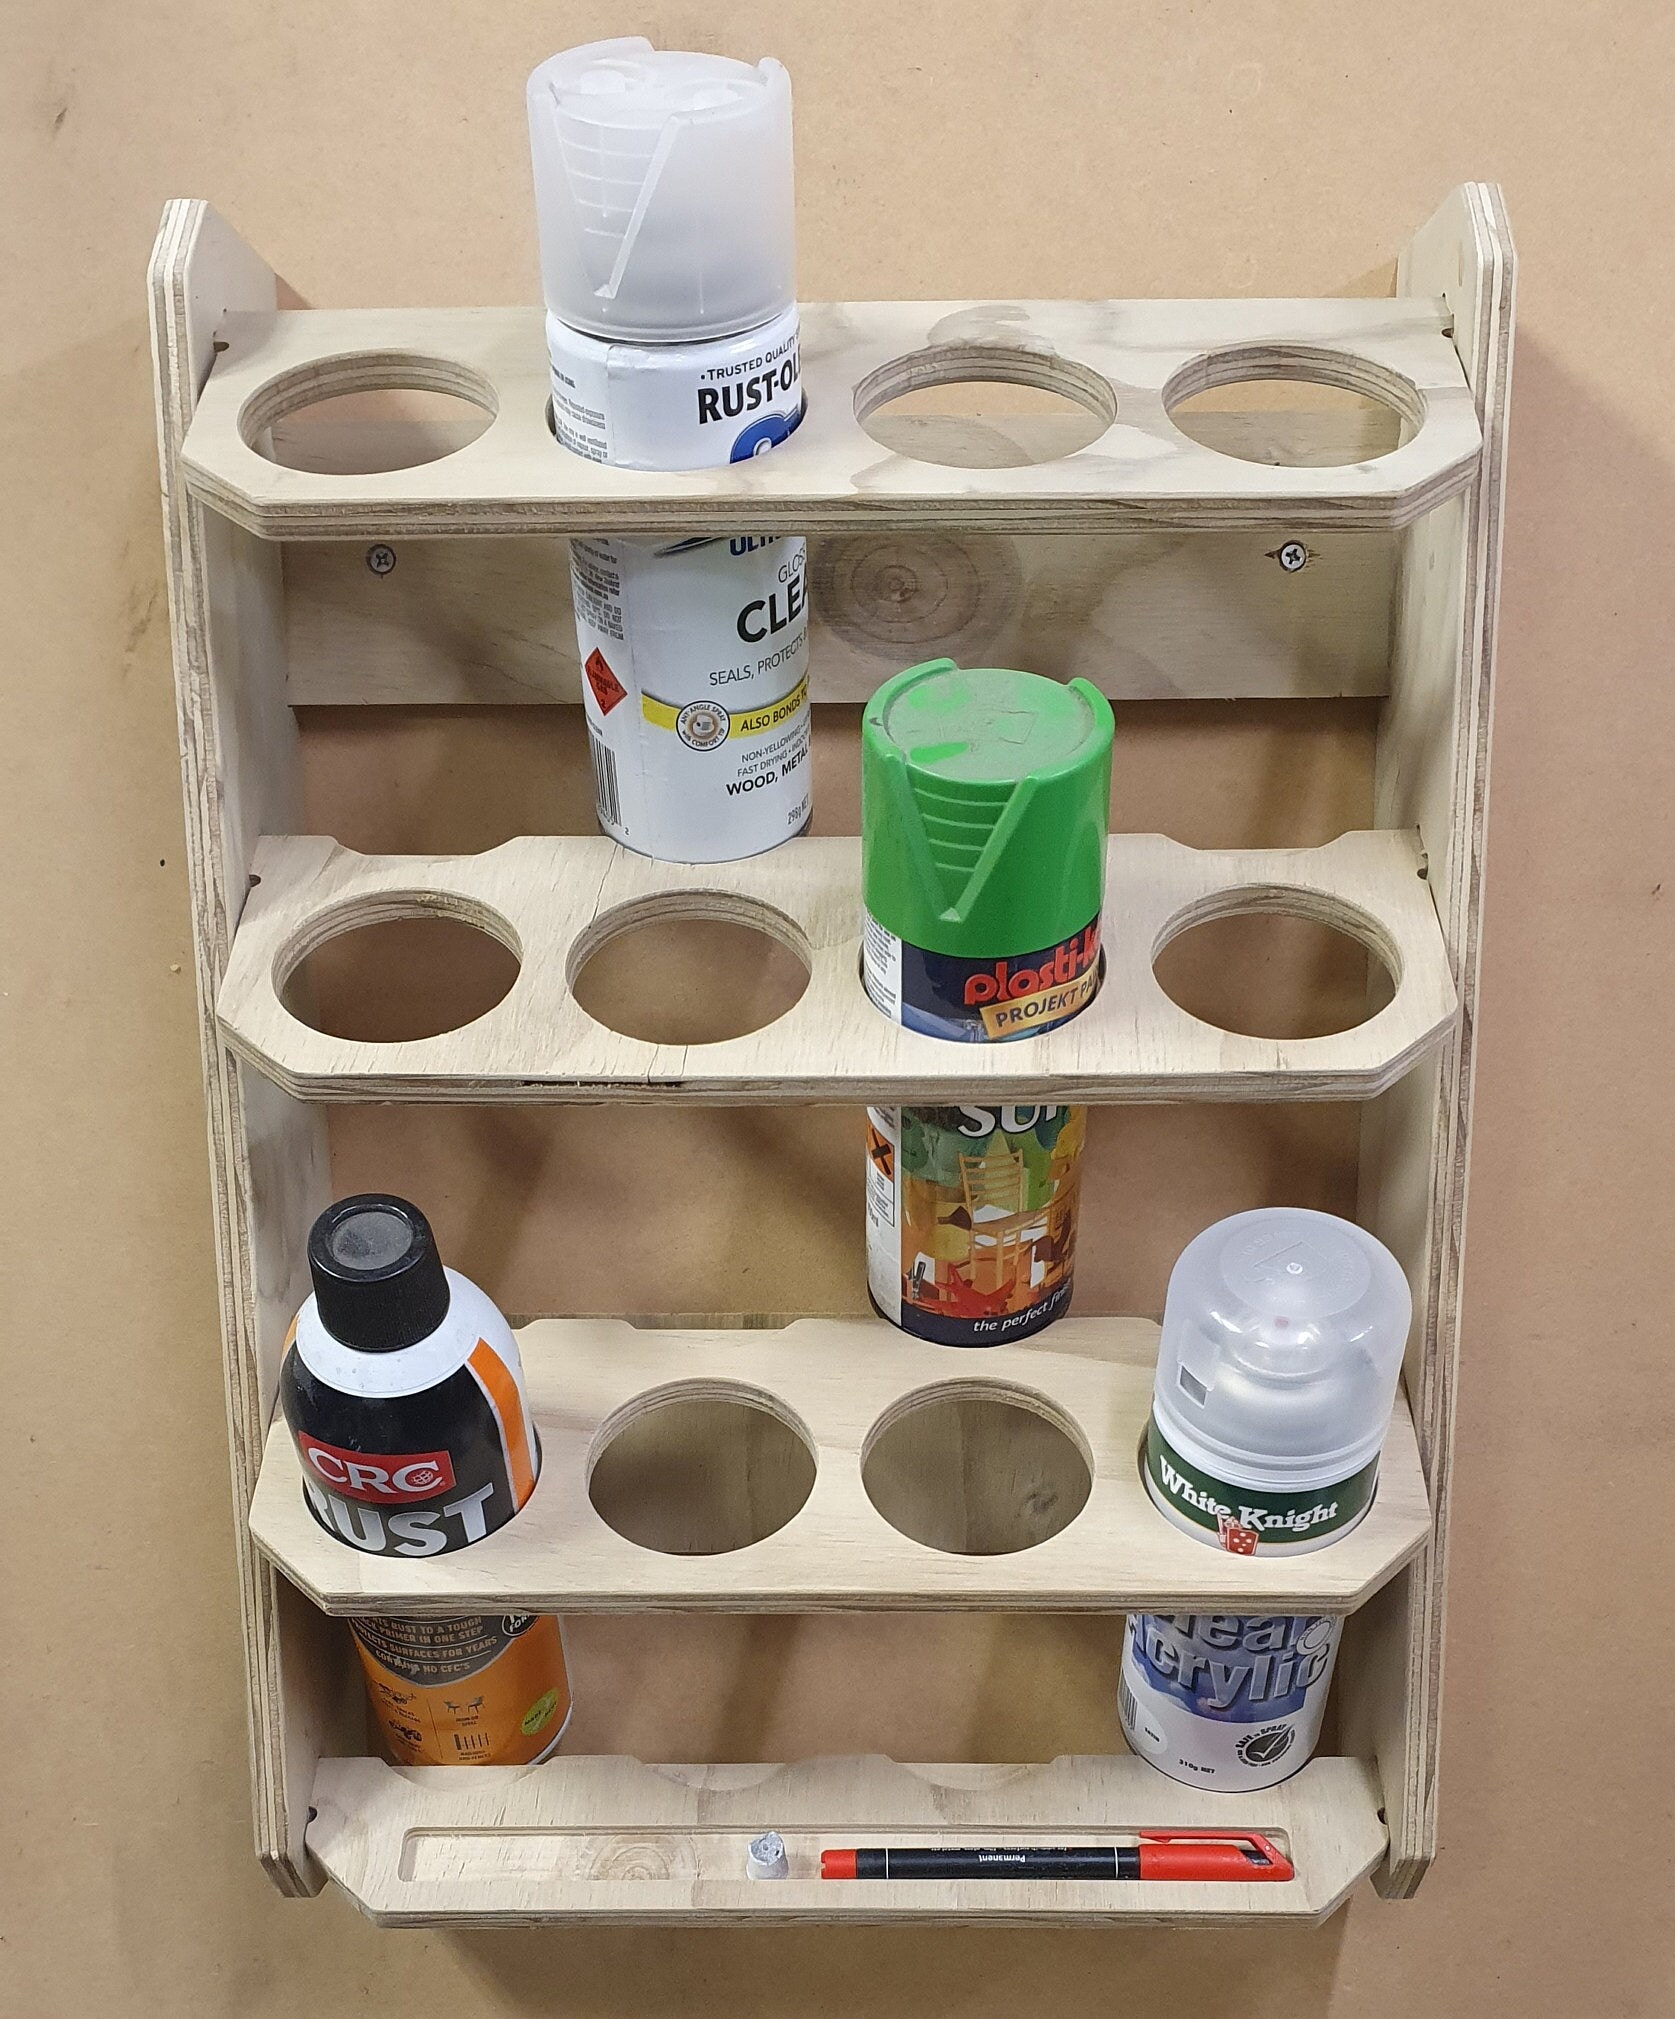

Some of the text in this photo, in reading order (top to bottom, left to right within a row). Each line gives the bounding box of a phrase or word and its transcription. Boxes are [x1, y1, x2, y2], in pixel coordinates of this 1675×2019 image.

[706, 358, 763, 381] TRUSTED
[737, 562, 808, 643] CLEA
[709, 665, 755, 686] SEALS,
[740, 715, 771, 733] ALSO
[772, 696, 801, 723] BONDS
[737, 763, 759, 777] FAST
[760, 751, 788, 771] DRYING
[726, 771, 779, 796] WOOD,
[963, 924, 1100, 1006] plasti-k
[995, 988, 1080, 1028] PROJEKT
[973, 1319, 998, 1332] the
[1001, 1303, 1049, 1332] perfect
[307, 1447, 443, 1494] CRC
[1159, 1454, 1338, 1533] White Knight
[434, 1632, 456, 1644] ONE
[458, 1625, 484, 1640] STEP
[465, 1635, 498, 1653] YEARS
[423, 1664, 438, 1673] NO
[977, 1853, 1027, 1864] Permanent
